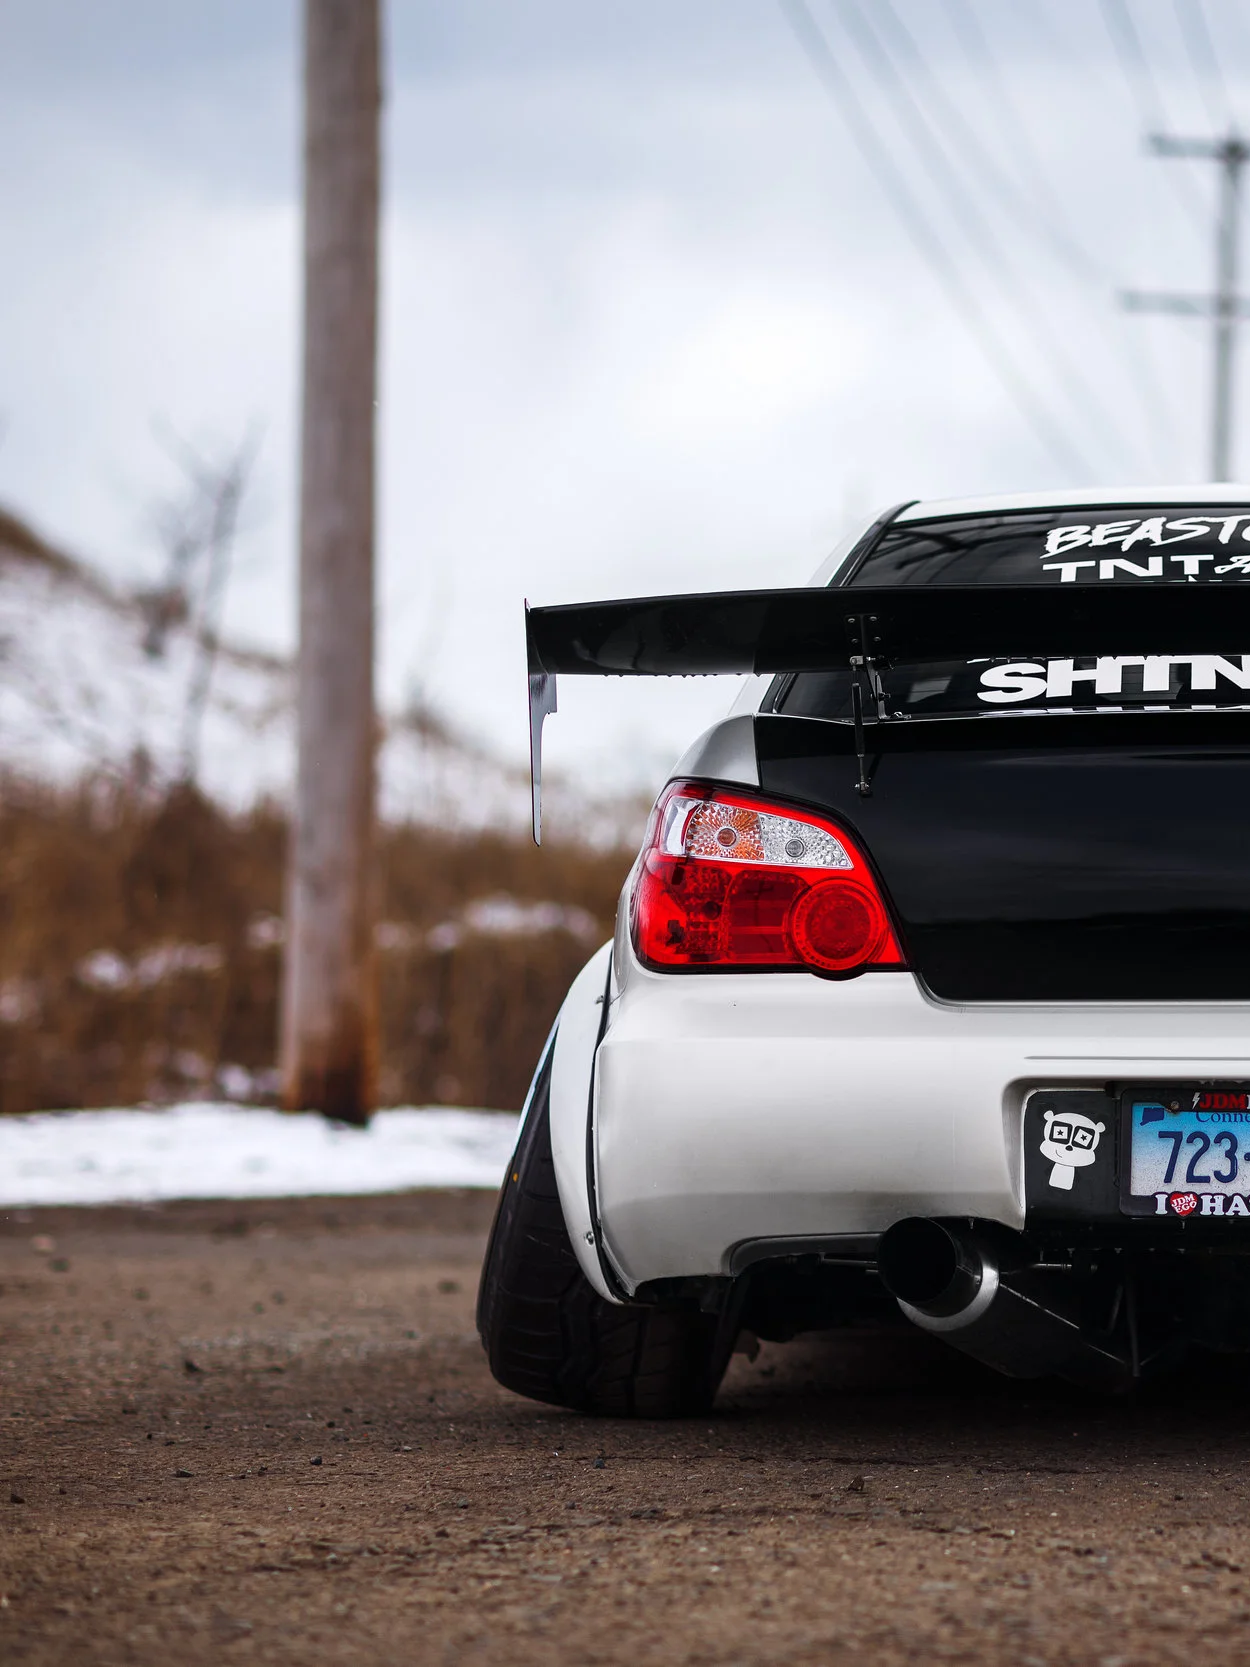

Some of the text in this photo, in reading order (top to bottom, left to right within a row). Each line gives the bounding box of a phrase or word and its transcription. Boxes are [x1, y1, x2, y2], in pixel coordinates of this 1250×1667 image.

[1042, 554, 1214, 583] TNT
[1155, 1194, 1168, 1215] I
[1171, 1193, 1195, 1207] JDM
[1174, 1201, 1197, 1213] EGO
